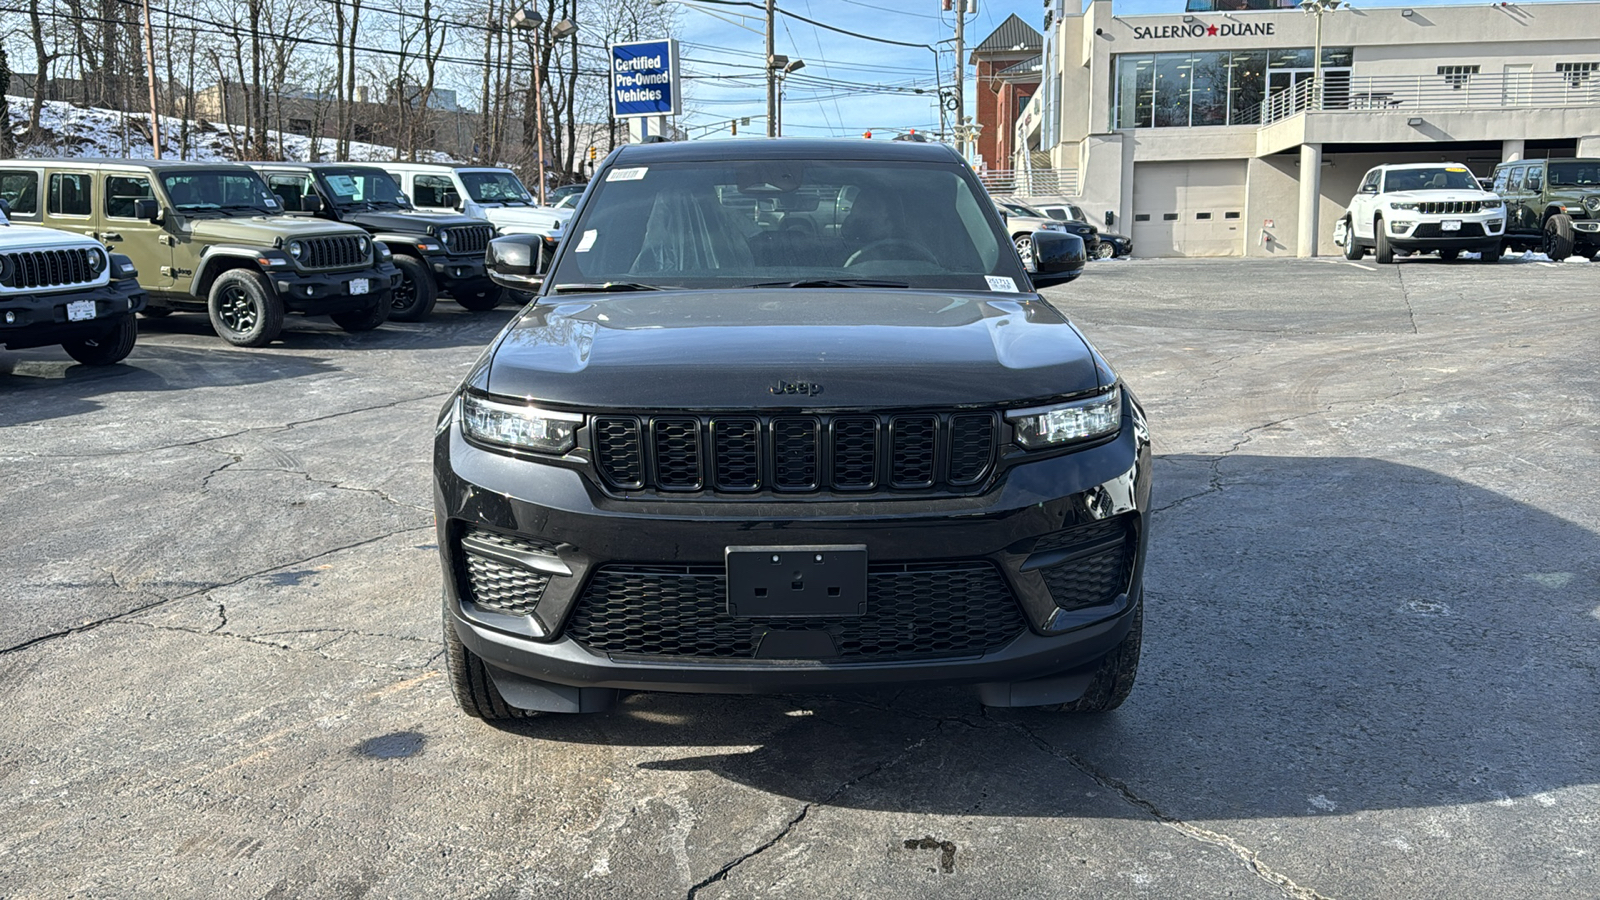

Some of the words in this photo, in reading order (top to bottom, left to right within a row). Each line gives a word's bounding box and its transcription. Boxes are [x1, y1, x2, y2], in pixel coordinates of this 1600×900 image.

[1134, 24, 1204, 39] SALERNO
[1220, 22, 1275, 37] DUANE
[615, 55, 661, 71] Certified
[616, 71, 668, 87] Pre-Owned
[617, 88, 662, 102] Vehicles
[769, 380, 824, 397] Jeep
